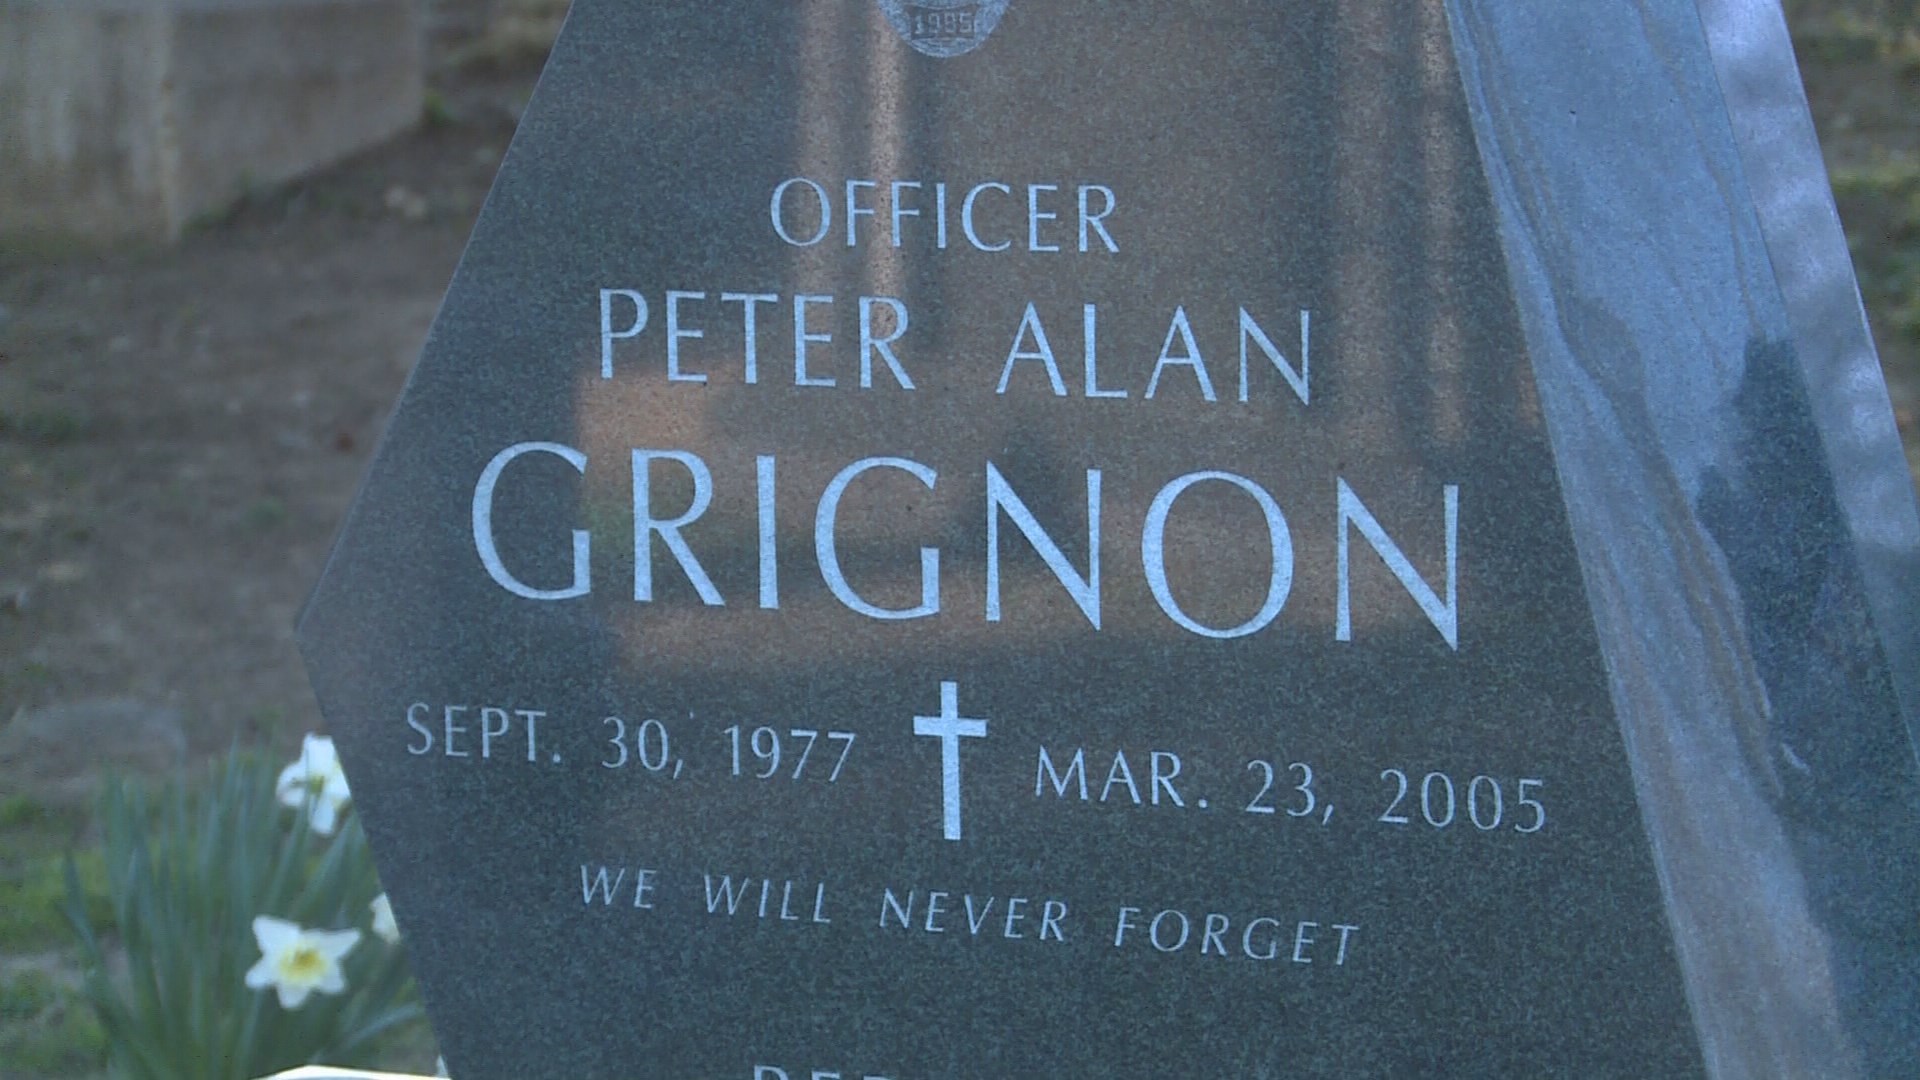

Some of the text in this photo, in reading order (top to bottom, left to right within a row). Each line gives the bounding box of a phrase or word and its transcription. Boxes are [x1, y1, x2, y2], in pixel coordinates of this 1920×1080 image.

[770, 177, 1121, 253] OFFICER
[600, 288, 1310, 406] PETER ALAN
[471, 440, 1461, 652] GRIGNON
[406, 702, 856, 782] SEPT. 30, 1977
[1034, 745, 1546, 833] MAR. 23, 2005
[580, 865, 1360, 966] WE WILL NEVER FORGET
